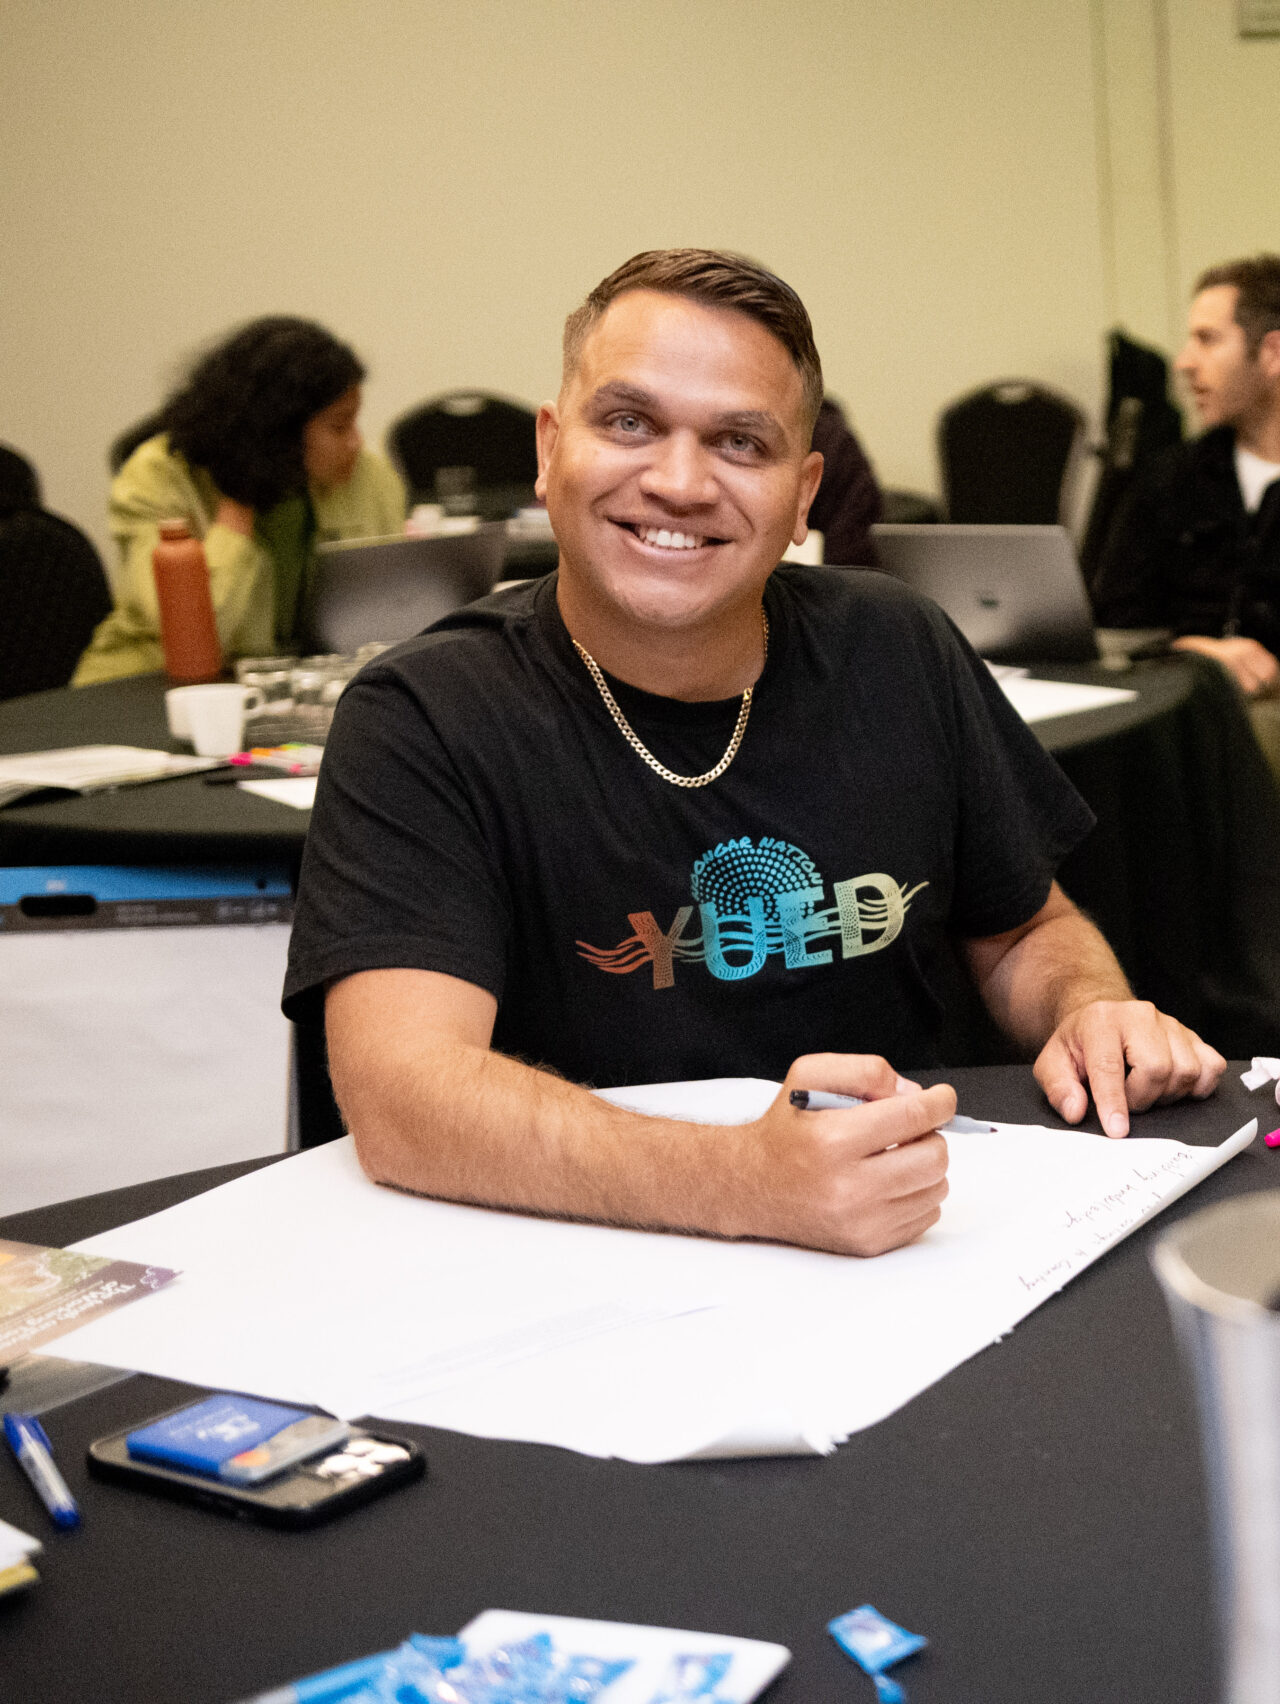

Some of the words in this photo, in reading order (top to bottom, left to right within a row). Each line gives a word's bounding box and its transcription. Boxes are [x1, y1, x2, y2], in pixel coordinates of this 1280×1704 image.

[690, 836, 753, 902] NOONGAR
[758, 836, 824, 885] NATION
[627, 872, 905, 990] YUED
